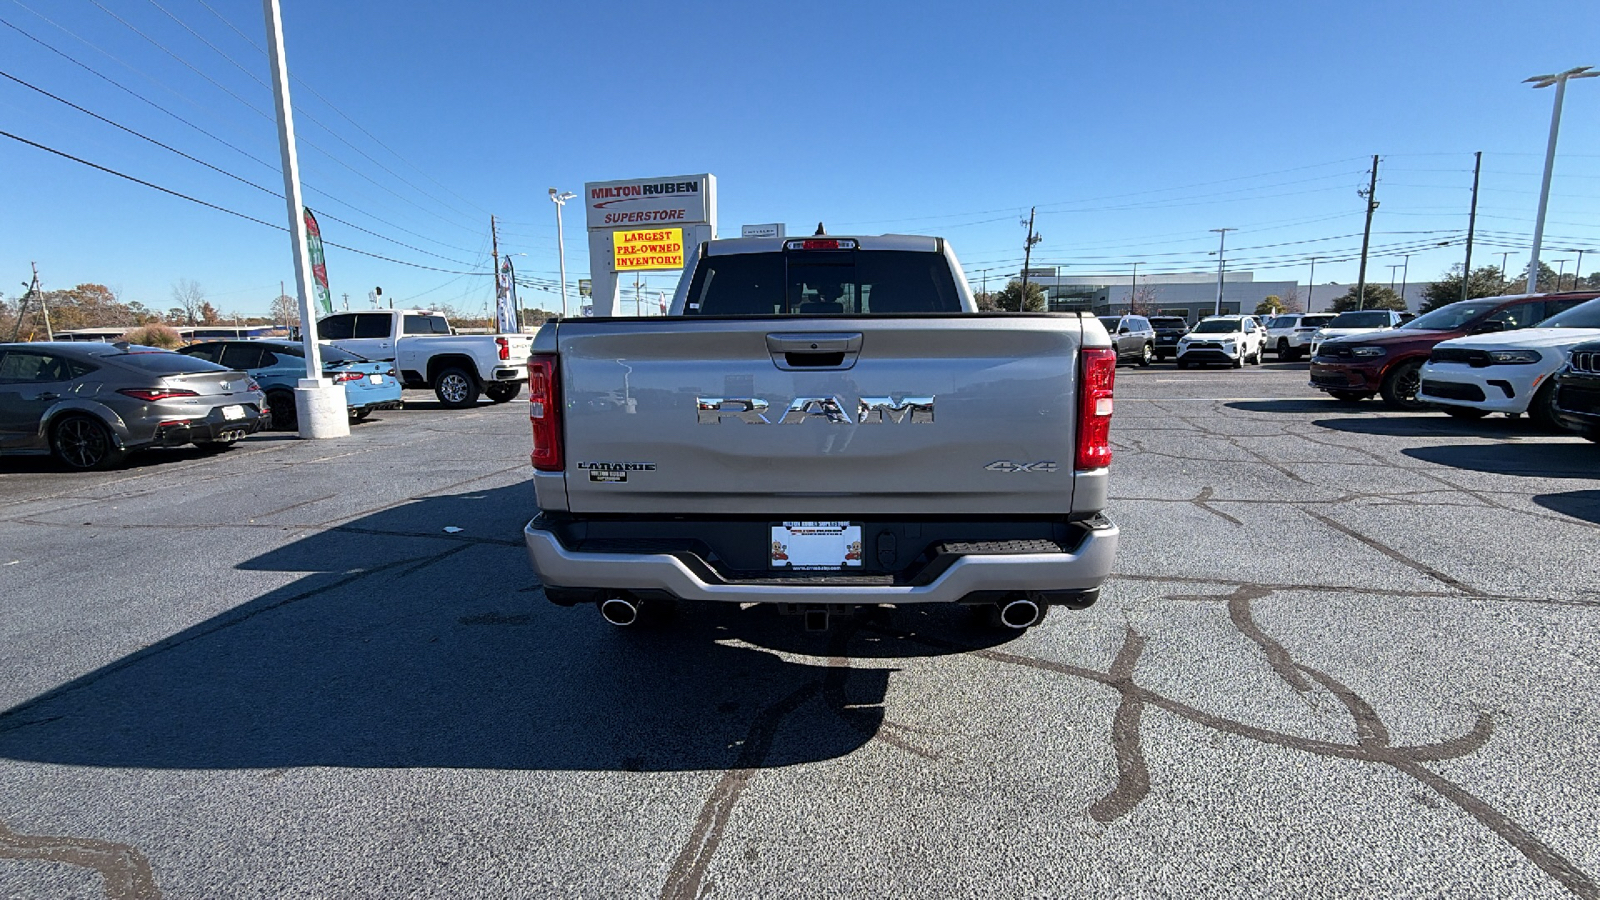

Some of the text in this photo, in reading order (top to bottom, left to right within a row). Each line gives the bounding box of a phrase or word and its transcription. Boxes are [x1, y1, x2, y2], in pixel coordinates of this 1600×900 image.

[591, 181, 699, 199] MILTON RUBEN
[604, 209, 686, 224] SUPERSTORE
[623, 231, 673, 242] LARGEST
[616, 243, 681, 255] PRE-OWNED
[616, 255, 682, 266] INVENTORY!
[696, 394, 936, 424] RAM
[577, 461, 656, 471] LARAMIE
[983, 460, 1059, 474] 4x4
